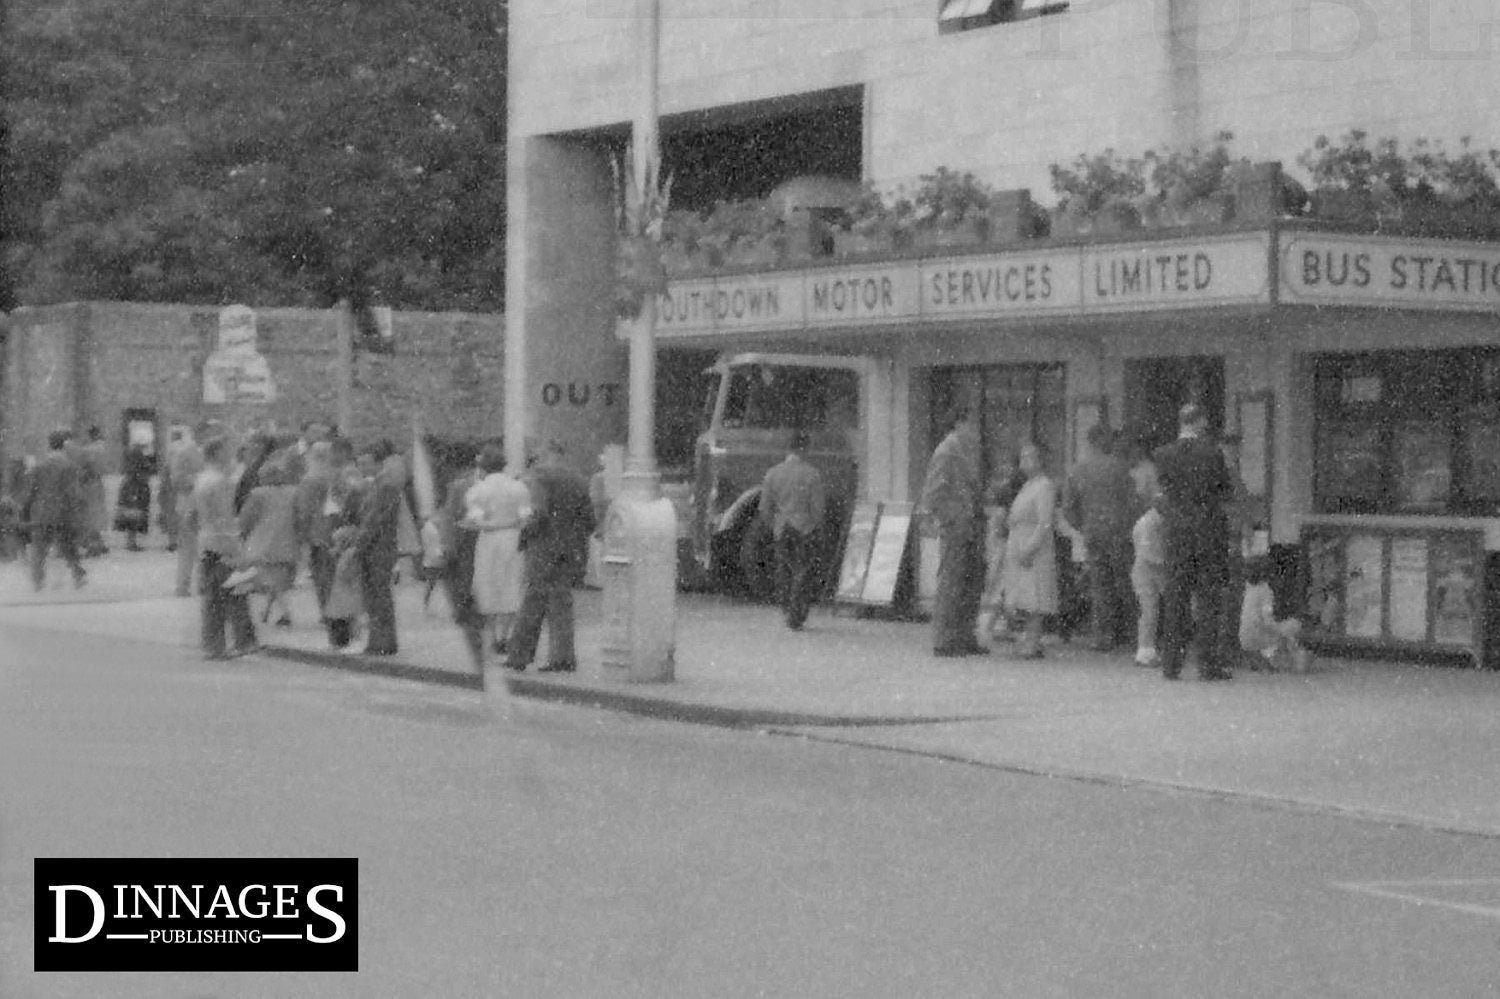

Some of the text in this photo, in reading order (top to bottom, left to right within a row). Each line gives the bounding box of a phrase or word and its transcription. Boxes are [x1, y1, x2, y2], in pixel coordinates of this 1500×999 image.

[660, 252, 1212, 322] OUTHDOWN MOTOR SERVICES LIMITED
[1302, 249, 1372, 288] BUS
[542, 382, 620, 407] OUT
